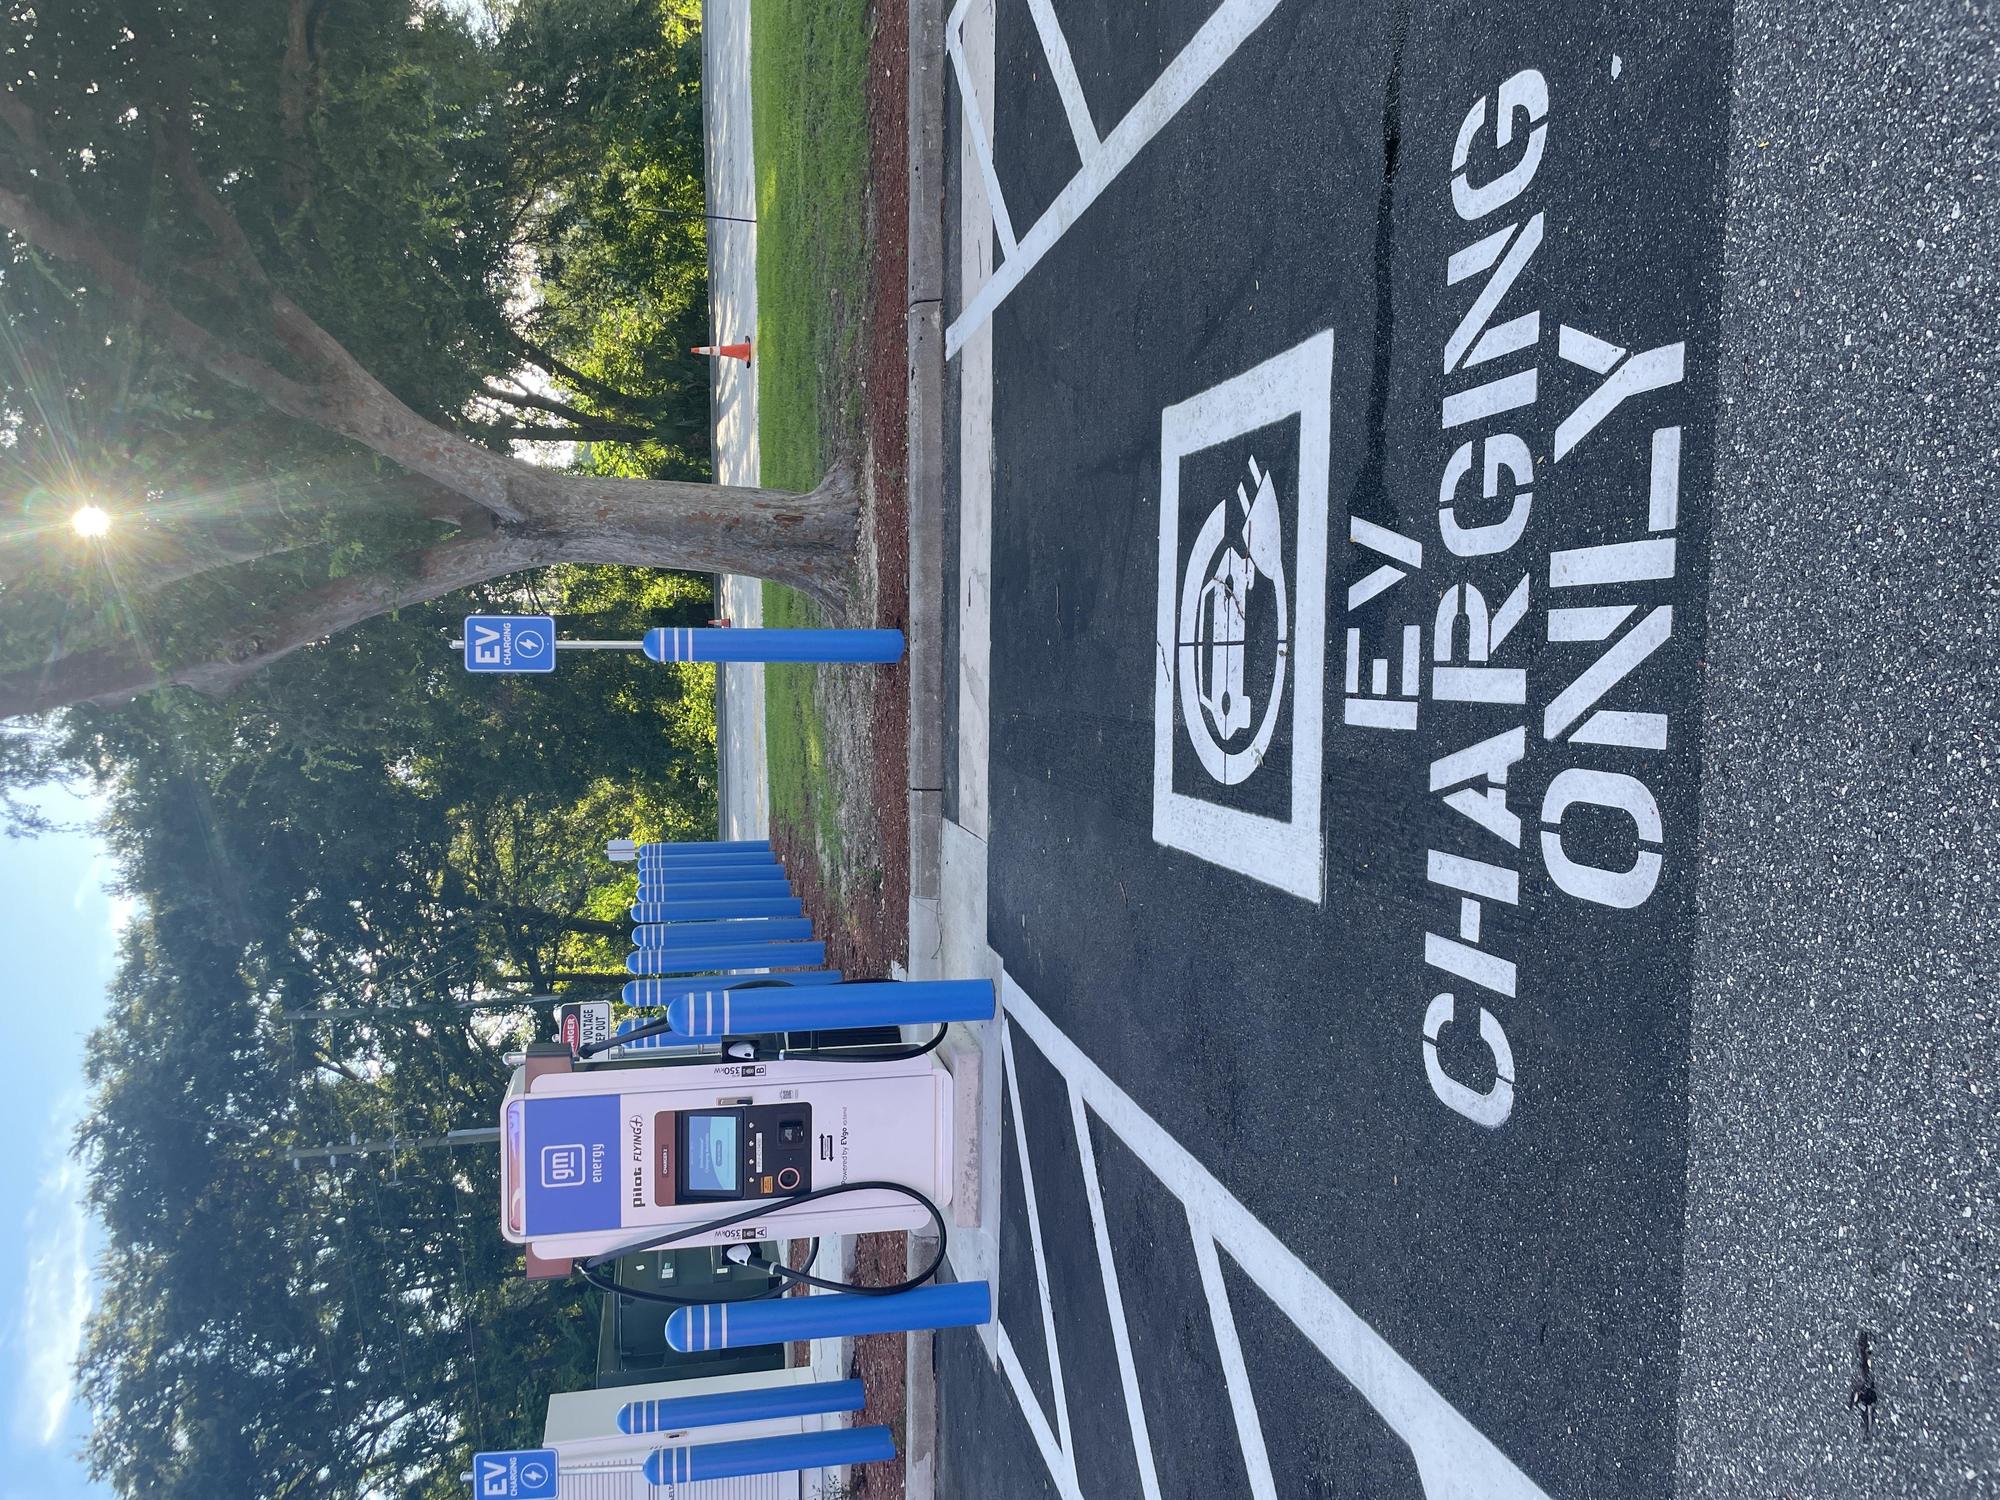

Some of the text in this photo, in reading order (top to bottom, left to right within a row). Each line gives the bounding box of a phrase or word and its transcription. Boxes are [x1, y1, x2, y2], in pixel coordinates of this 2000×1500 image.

[1422, 69, 1549, 1129] CHARGING
[1540, 324, 1685, 910] ONLY
[1344, 515, 1422, 731] EV
[475, 625, 500, 663] EV
[503, 622, 511, 665] CHARGING
[583, 1010, 593, 1040] VOLTAGE
[596, 1017, 605, 1030] OUT
[592, 1144, 604, 1182] energy
[633, 1128, 642, 1162] FLYING
[841, 1147, 848, 1156] by
[552, 1152, 574, 1180] gm
[633, 1167, 646, 1208] pilot
[484, 1461, 507, 1496] EV
